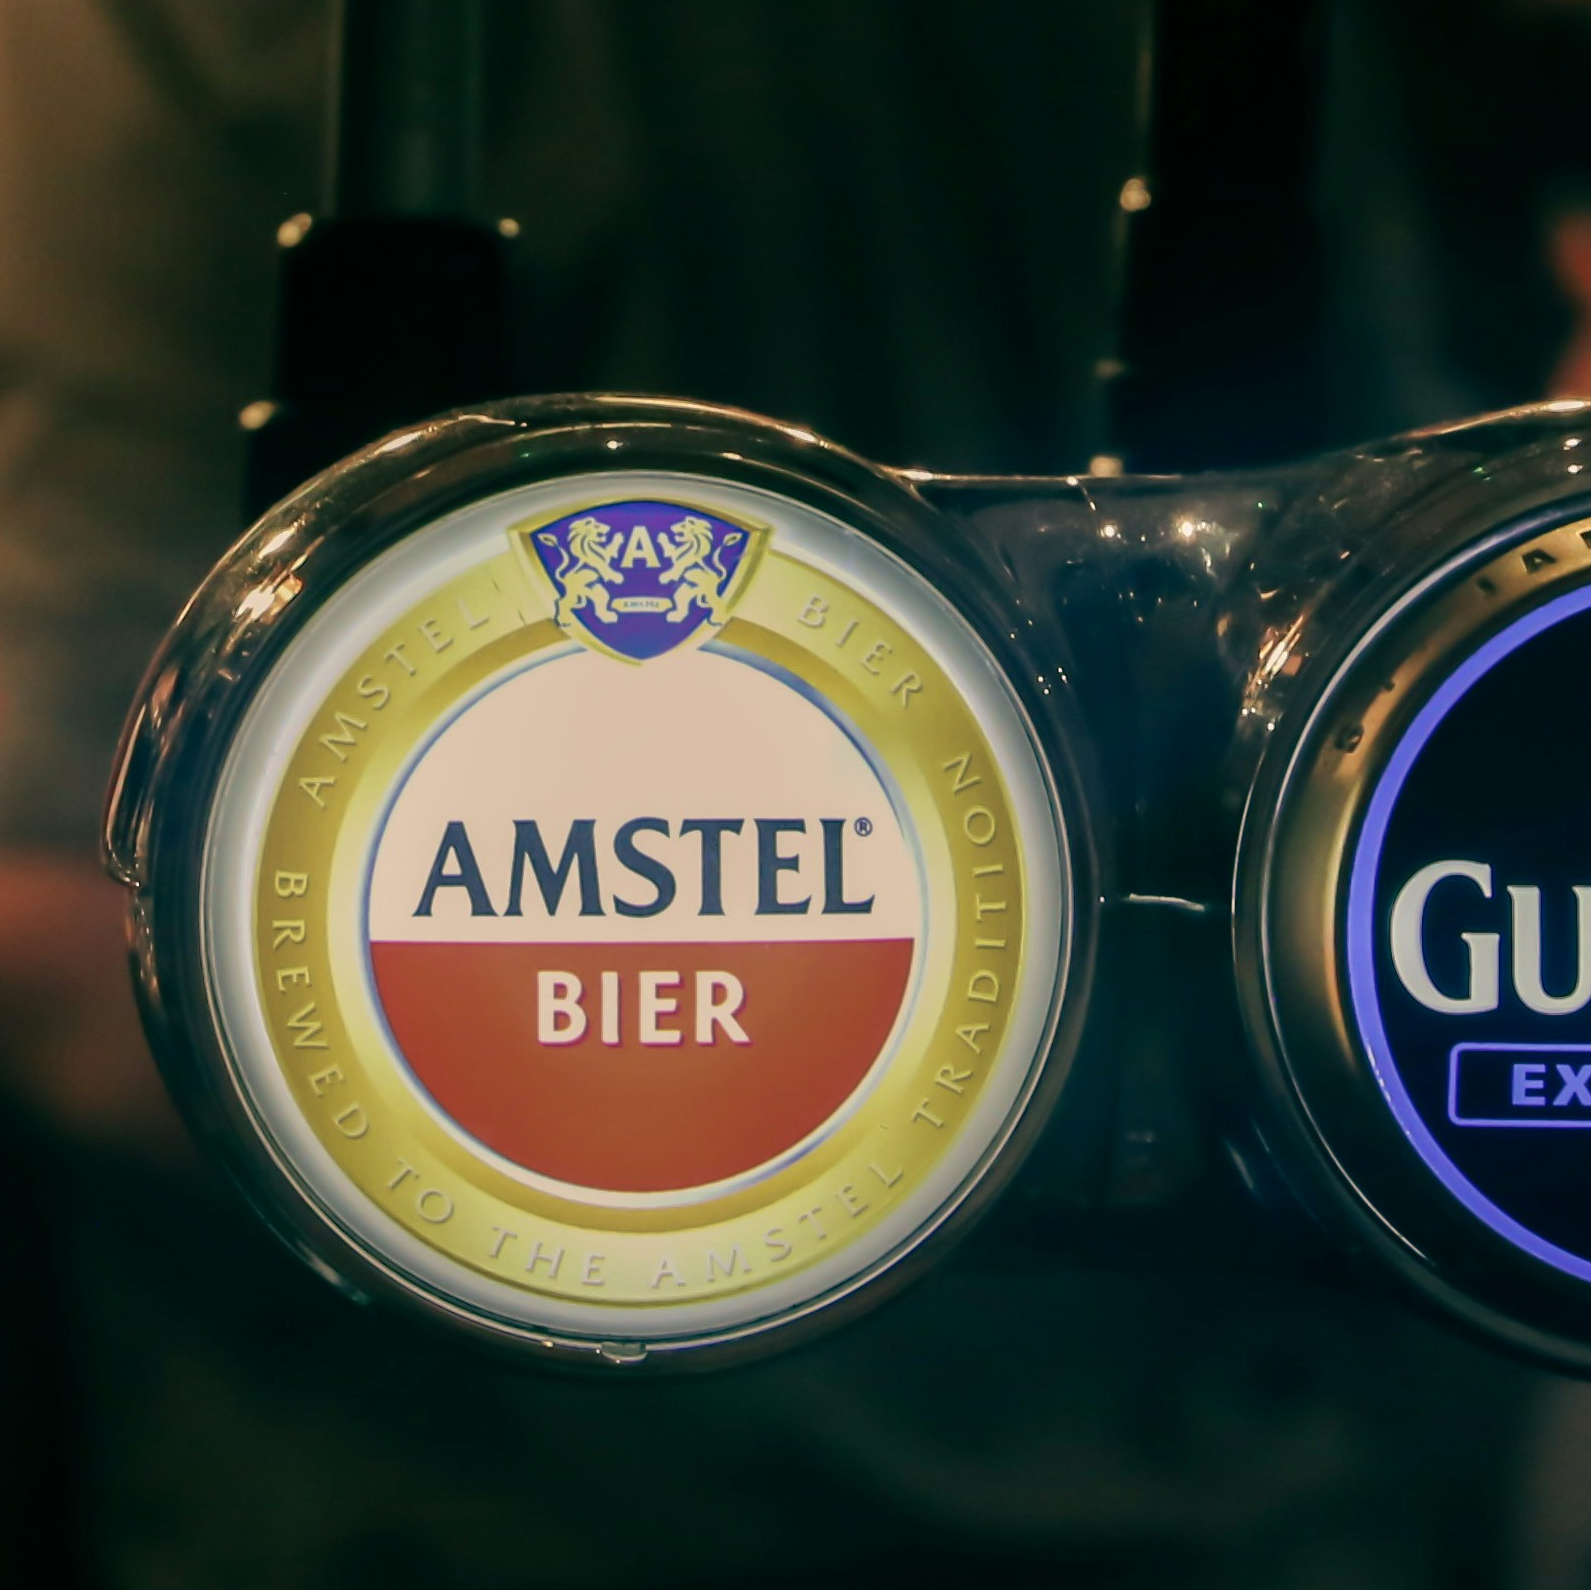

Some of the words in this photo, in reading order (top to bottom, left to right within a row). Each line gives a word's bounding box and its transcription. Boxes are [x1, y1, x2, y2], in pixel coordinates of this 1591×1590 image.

[620, 525, 662, 568] A
[298, 598, 490, 808] AMSTEL
[797, 595, 924, 708] BIER
[271, 869, 370, 1140] BREWED
[387, 1158, 454, 1224] TO
[487, 1226, 606, 1287] THE
[651, 1154, 905, 1289] AMSTEL
[912, 751, 1008, 1130] TRADITION
[536, 970, 752, 1047] BIER
